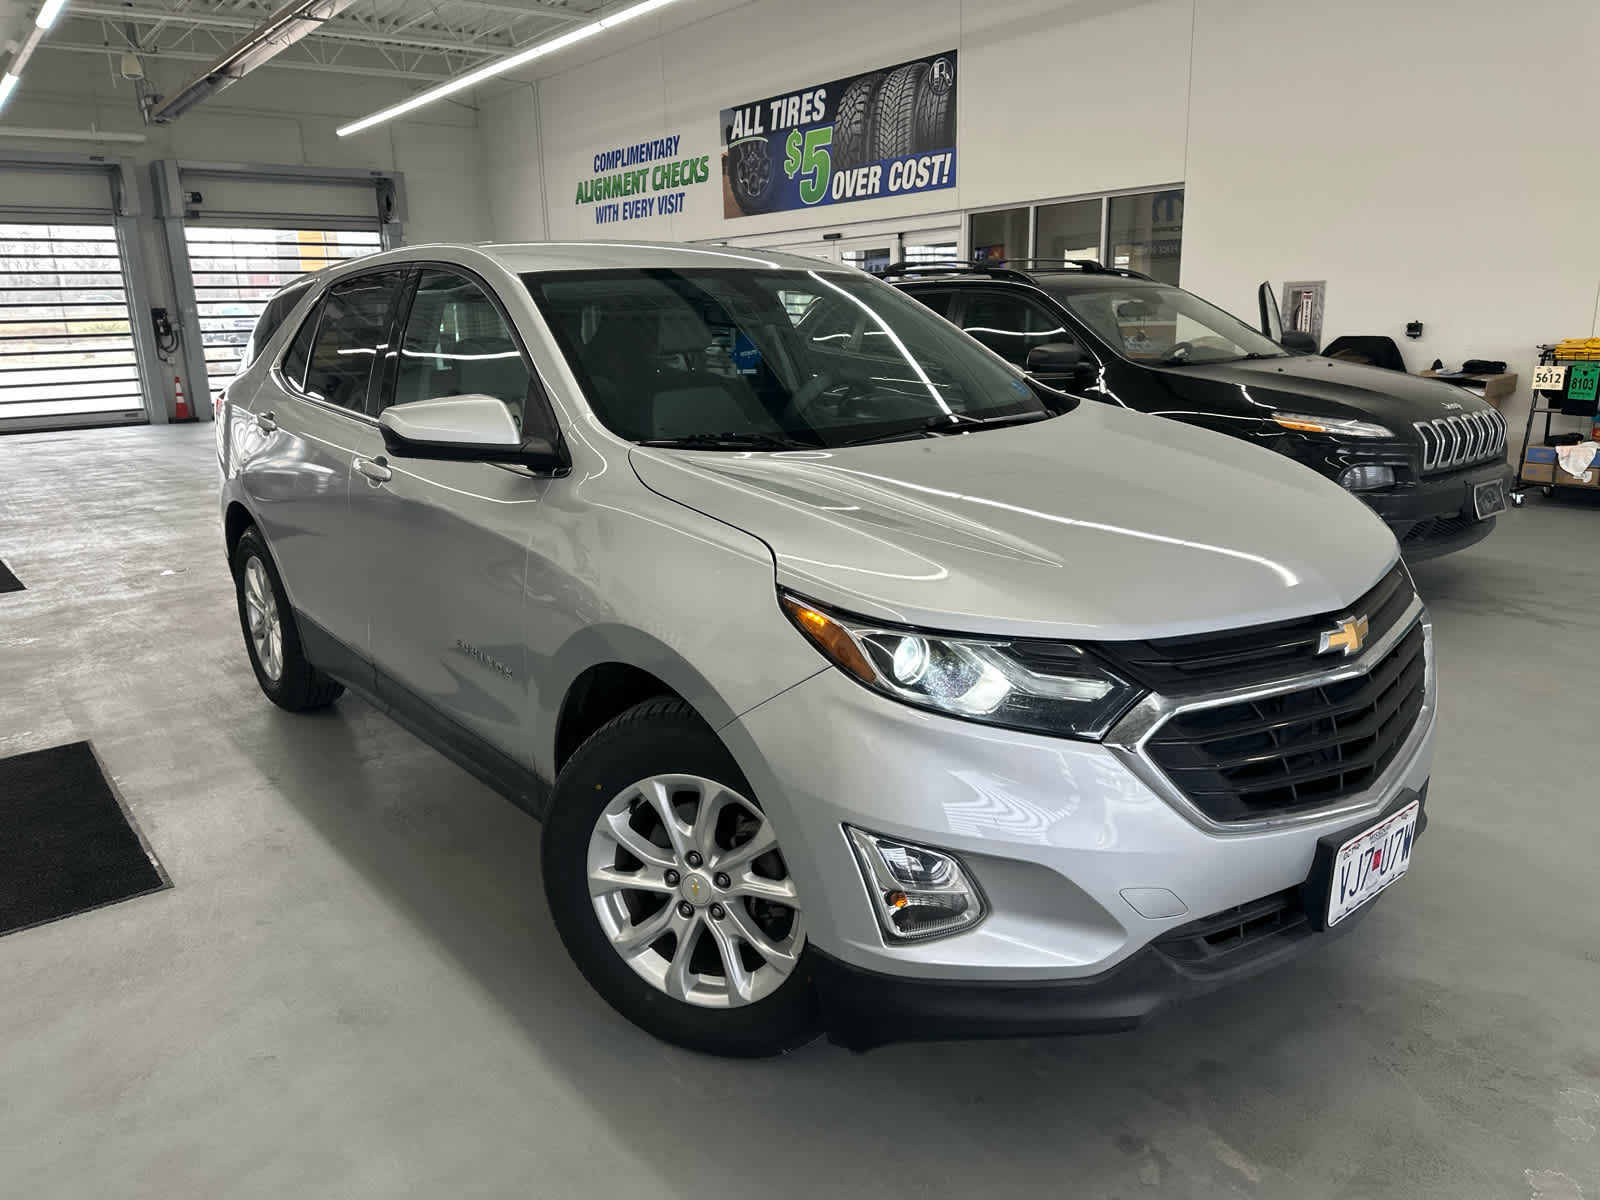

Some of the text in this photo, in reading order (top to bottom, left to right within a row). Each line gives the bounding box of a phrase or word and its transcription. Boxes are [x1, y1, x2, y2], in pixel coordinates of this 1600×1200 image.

[731, 88, 827, 140] ALL TIRES
[594, 135, 680, 173] COMPLIMENTARY
[783, 126, 833, 205] $5
[575, 155, 710, 205] ALIGNMENT CHECKS
[831, 152, 953, 200] OVER COST!
[595, 192, 686, 224] WITH EVERY VISIT
[1536, 373, 1561, 383] 5612
[1572, 378, 1594, 390] 8103
